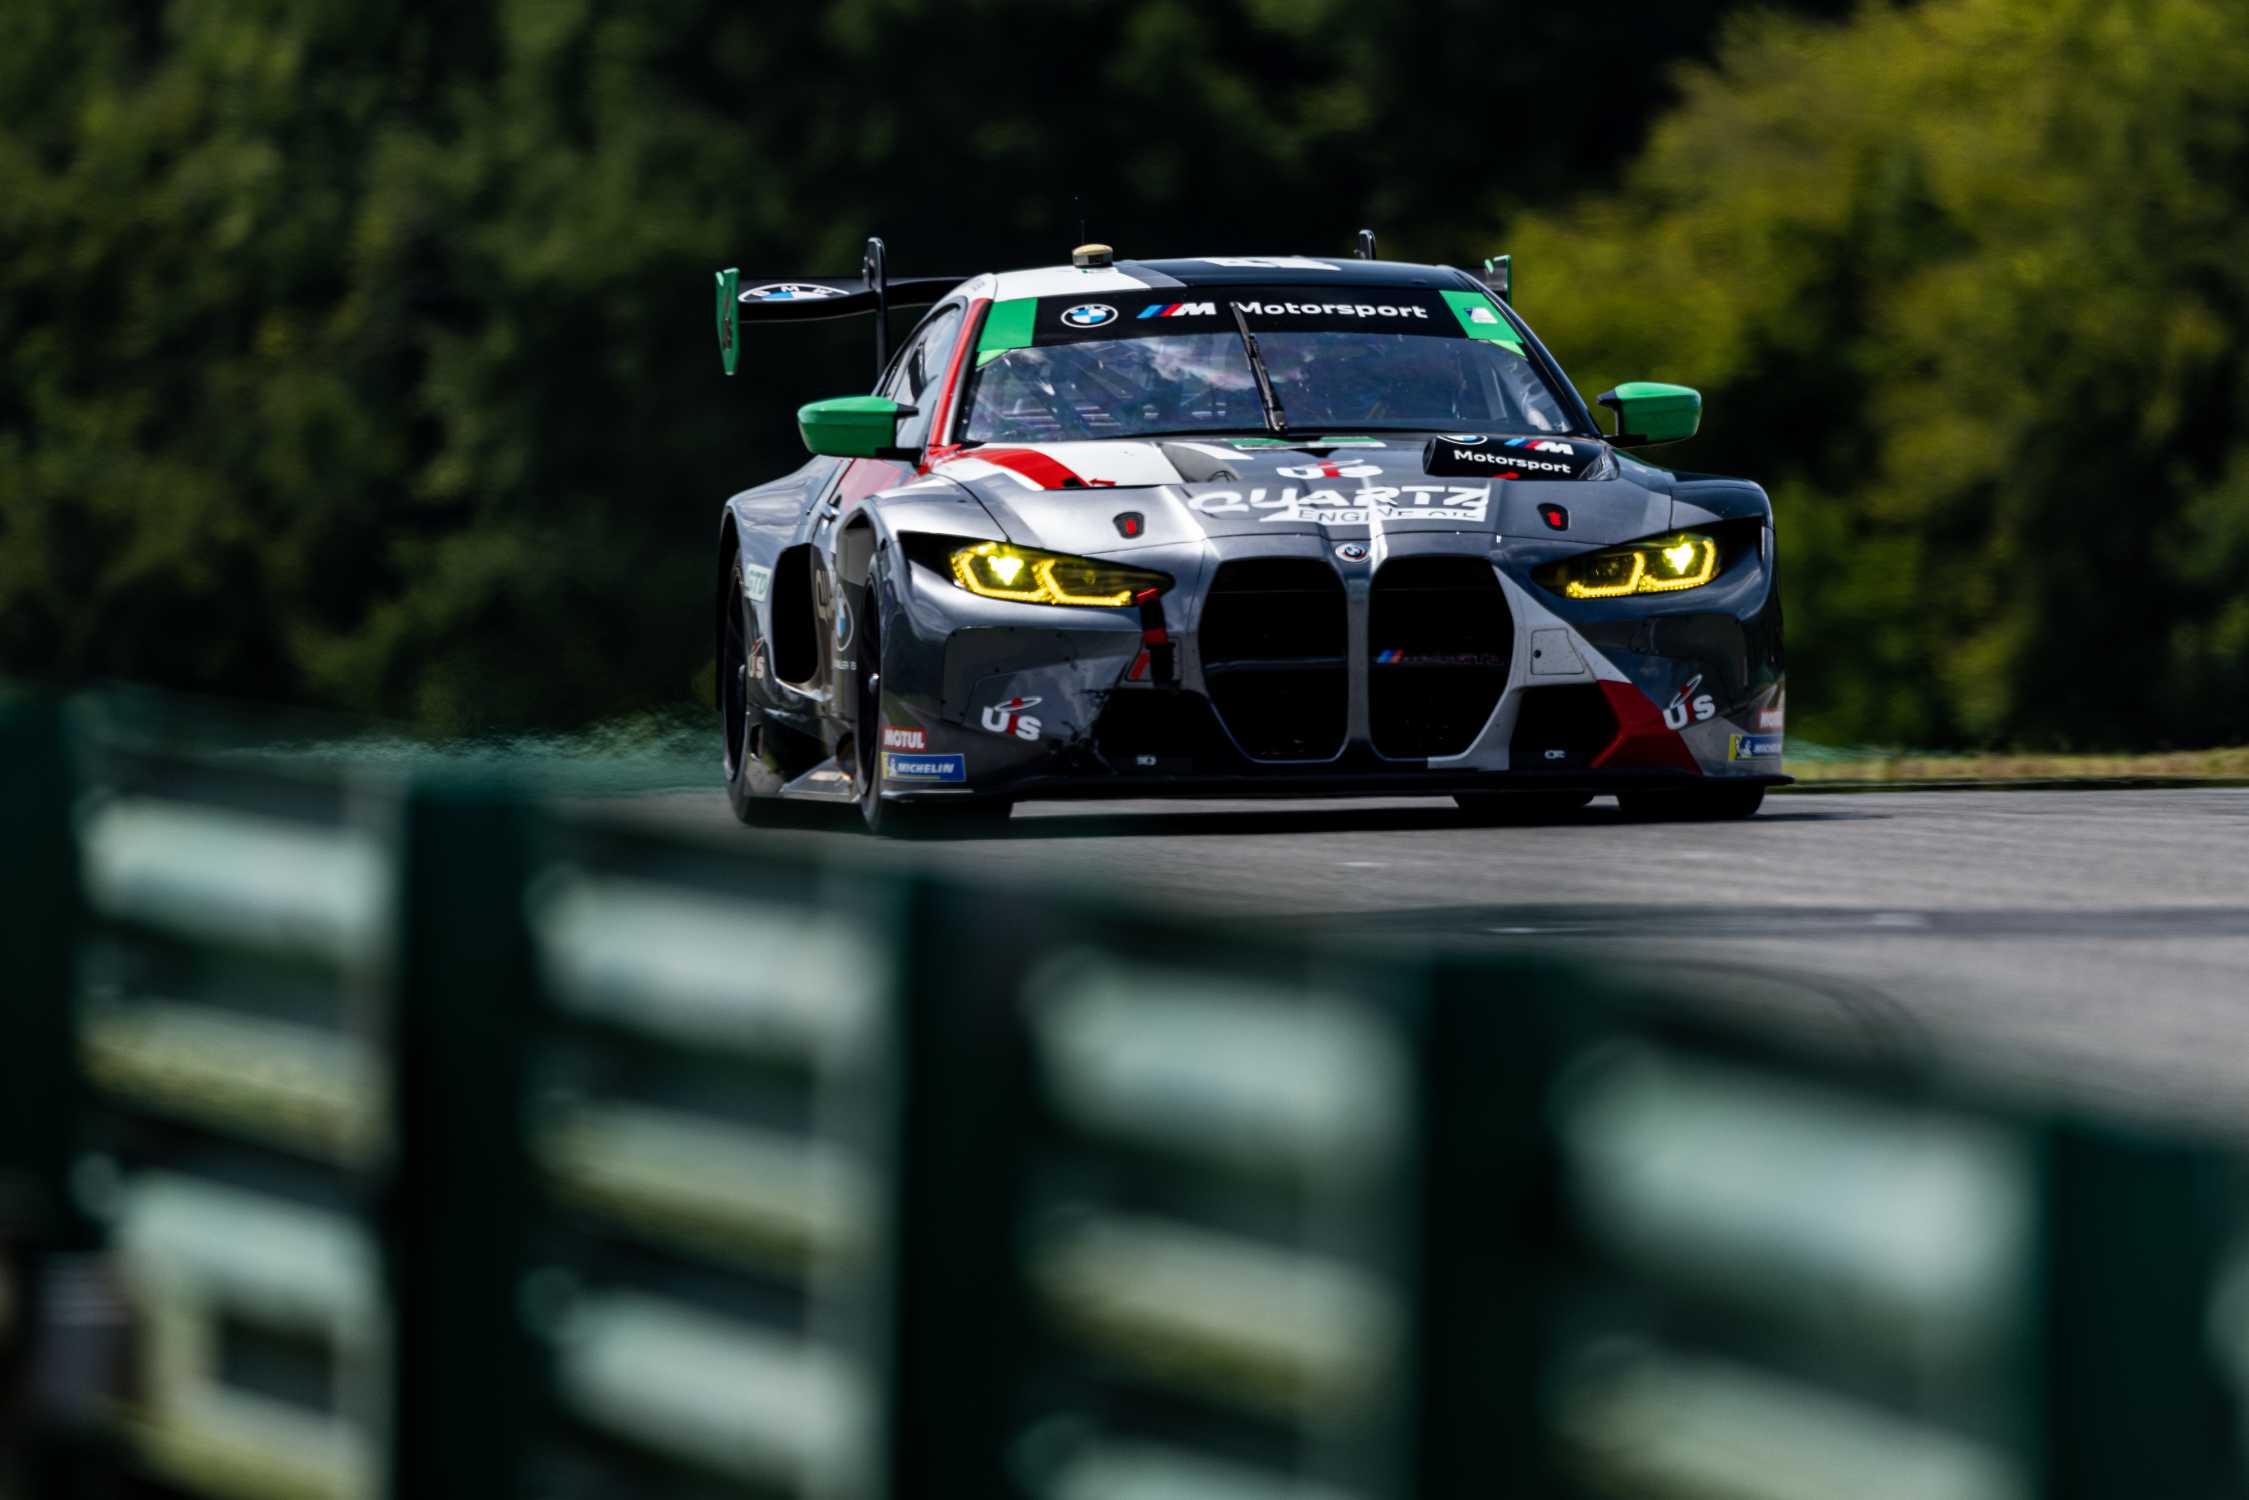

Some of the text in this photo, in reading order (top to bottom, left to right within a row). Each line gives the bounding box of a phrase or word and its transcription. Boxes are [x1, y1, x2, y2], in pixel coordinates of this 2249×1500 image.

[1236, 301, 1429, 319] Motorsport
[1453, 449, 1572, 474] Motorsport
[1187, 485, 1490, 514] QUARTZ
[884, 729, 925, 748] MOTUL
[897, 762, 955, 774] MICHELIN
